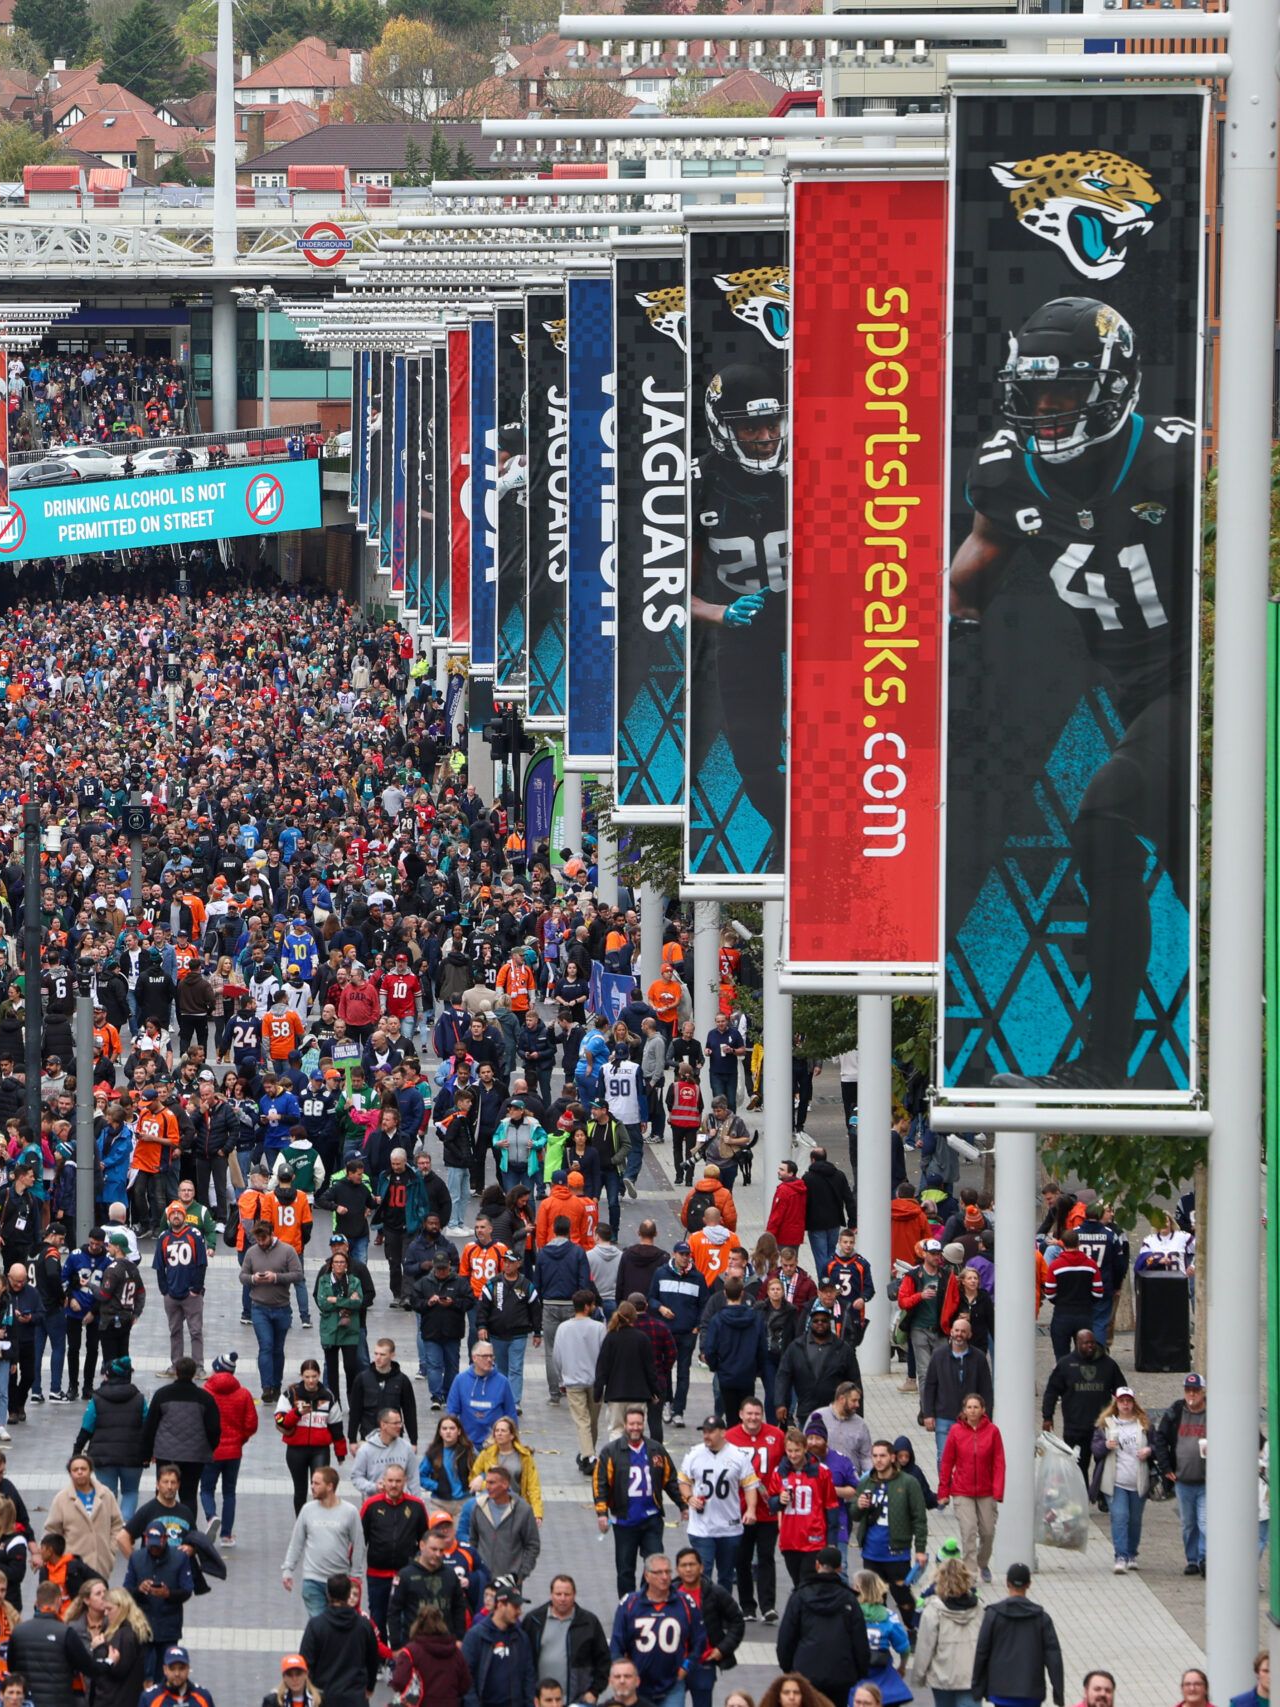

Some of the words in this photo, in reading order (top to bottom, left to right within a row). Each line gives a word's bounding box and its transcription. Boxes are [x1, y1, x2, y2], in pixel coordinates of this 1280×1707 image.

[43, 494, 110, 518] DRINKING
[113, 487, 178, 511] ALCOHOL
[181, 485, 195, 503] IS
[198, 482, 226, 501] NOT
[641, 375, 687, 633] JAGUARS
[58, 518, 137, 543] PERMITTED
[140, 515, 160, 534] ON
[163, 509, 215, 531] STREET
[856, 286, 921, 858] sportsbreaks.com
[1049, 543, 1169, 630] 41
[207, 672, 217, 682] 80
[340, 693, 350, 704] 91
[83, 784, 94, 796] 12
[401, 818, 413, 830] 28
[176, 955, 190, 969] 58
[291, 944, 306, 959] 10
[55, 978, 66, 999] 6
[148, 976, 165, 984] STAFF
[393, 982, 407, 998] 10
[295, 990, 302, 1008] 7
[349, 992, 368, 1001] GAP
[233, 1026, 257, 1047] 24
[271, 1021, 290, 1037] 58
[610, 1079, 630, 1096] 90
[302, 1100, 324, 1116] 88
[141, 1119, 160, 1136] 58
[389, 1185, 407, 1207] 10
[277, 1206, 296, 1226] 18
[166, 1243, 193, 1266] 30
[708, 1249, 721, 1271] 3
[27, 1263, 37, 1288] 9
[471, 1258, 497, 1280] 58
[120, 1281, 136, 1305] 12
[838, 1273, 852, 1296] 3
[628, 1466, 653, 1497] 21
[701, 1469, 730, 1500] 56
[634, 1617, 682, 1654] 30
